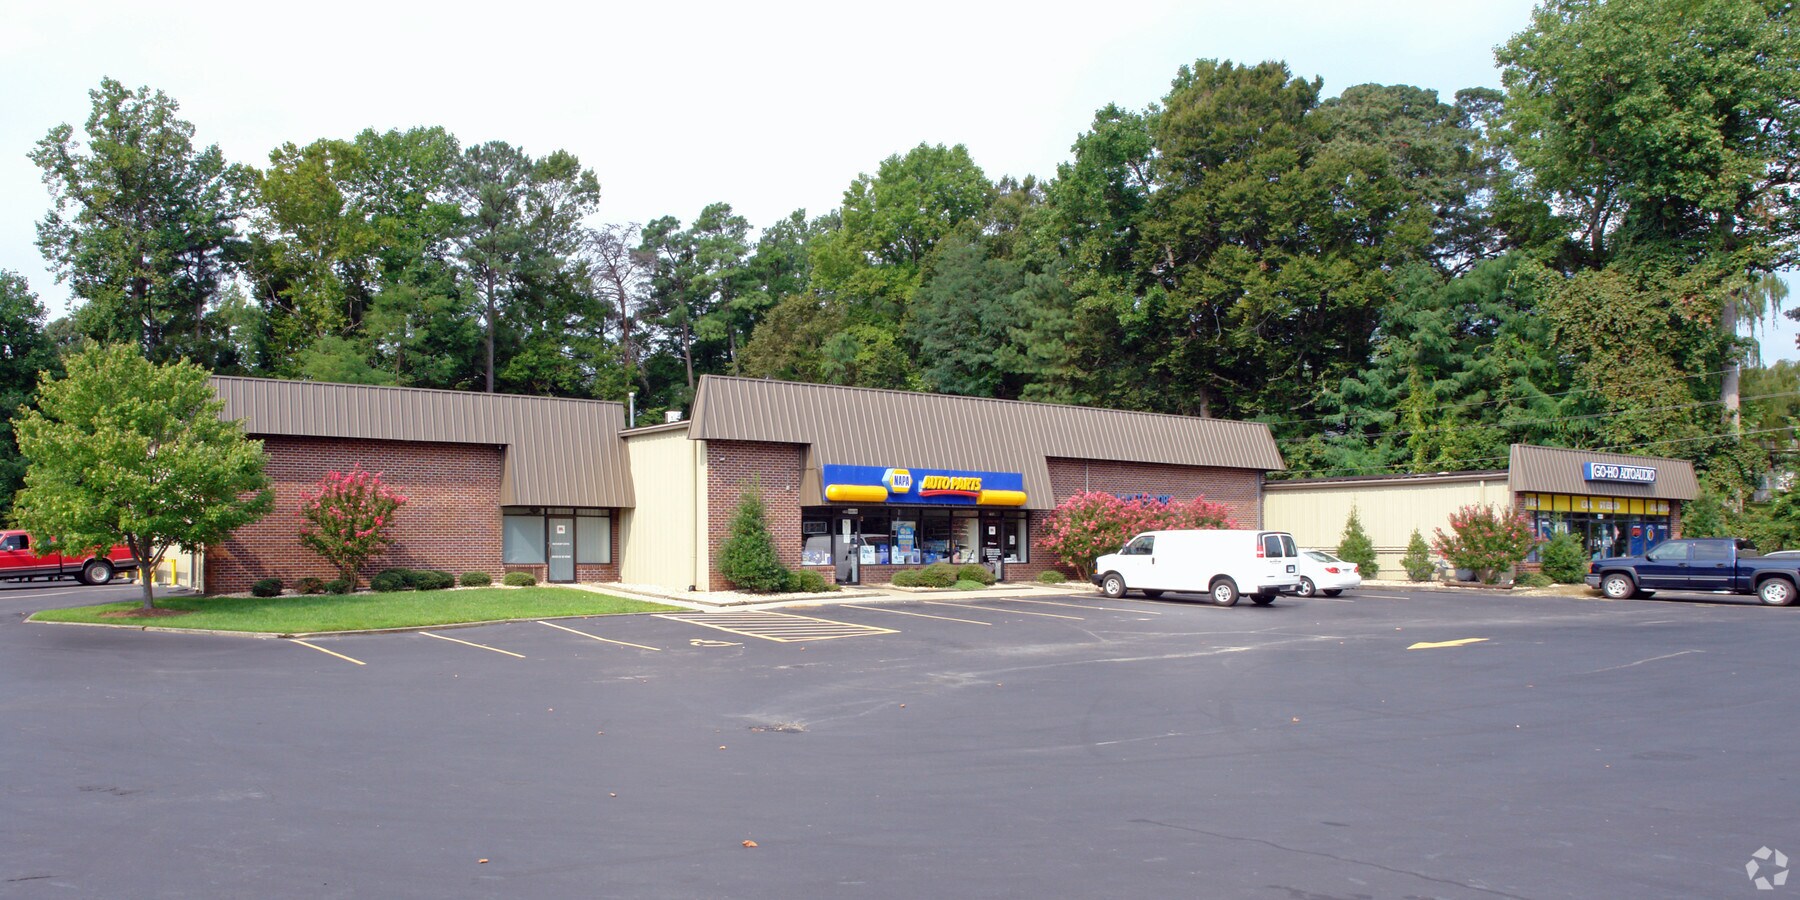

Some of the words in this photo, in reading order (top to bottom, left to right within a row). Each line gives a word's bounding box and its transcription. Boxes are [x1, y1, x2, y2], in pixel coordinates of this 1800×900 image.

[1594, 465, 1619, 479] GO-HO
[893, 475, 909, 486] NAPA
[922, 475, 949, 489] AUTO
[950, 477, 981, 490] PARTS
